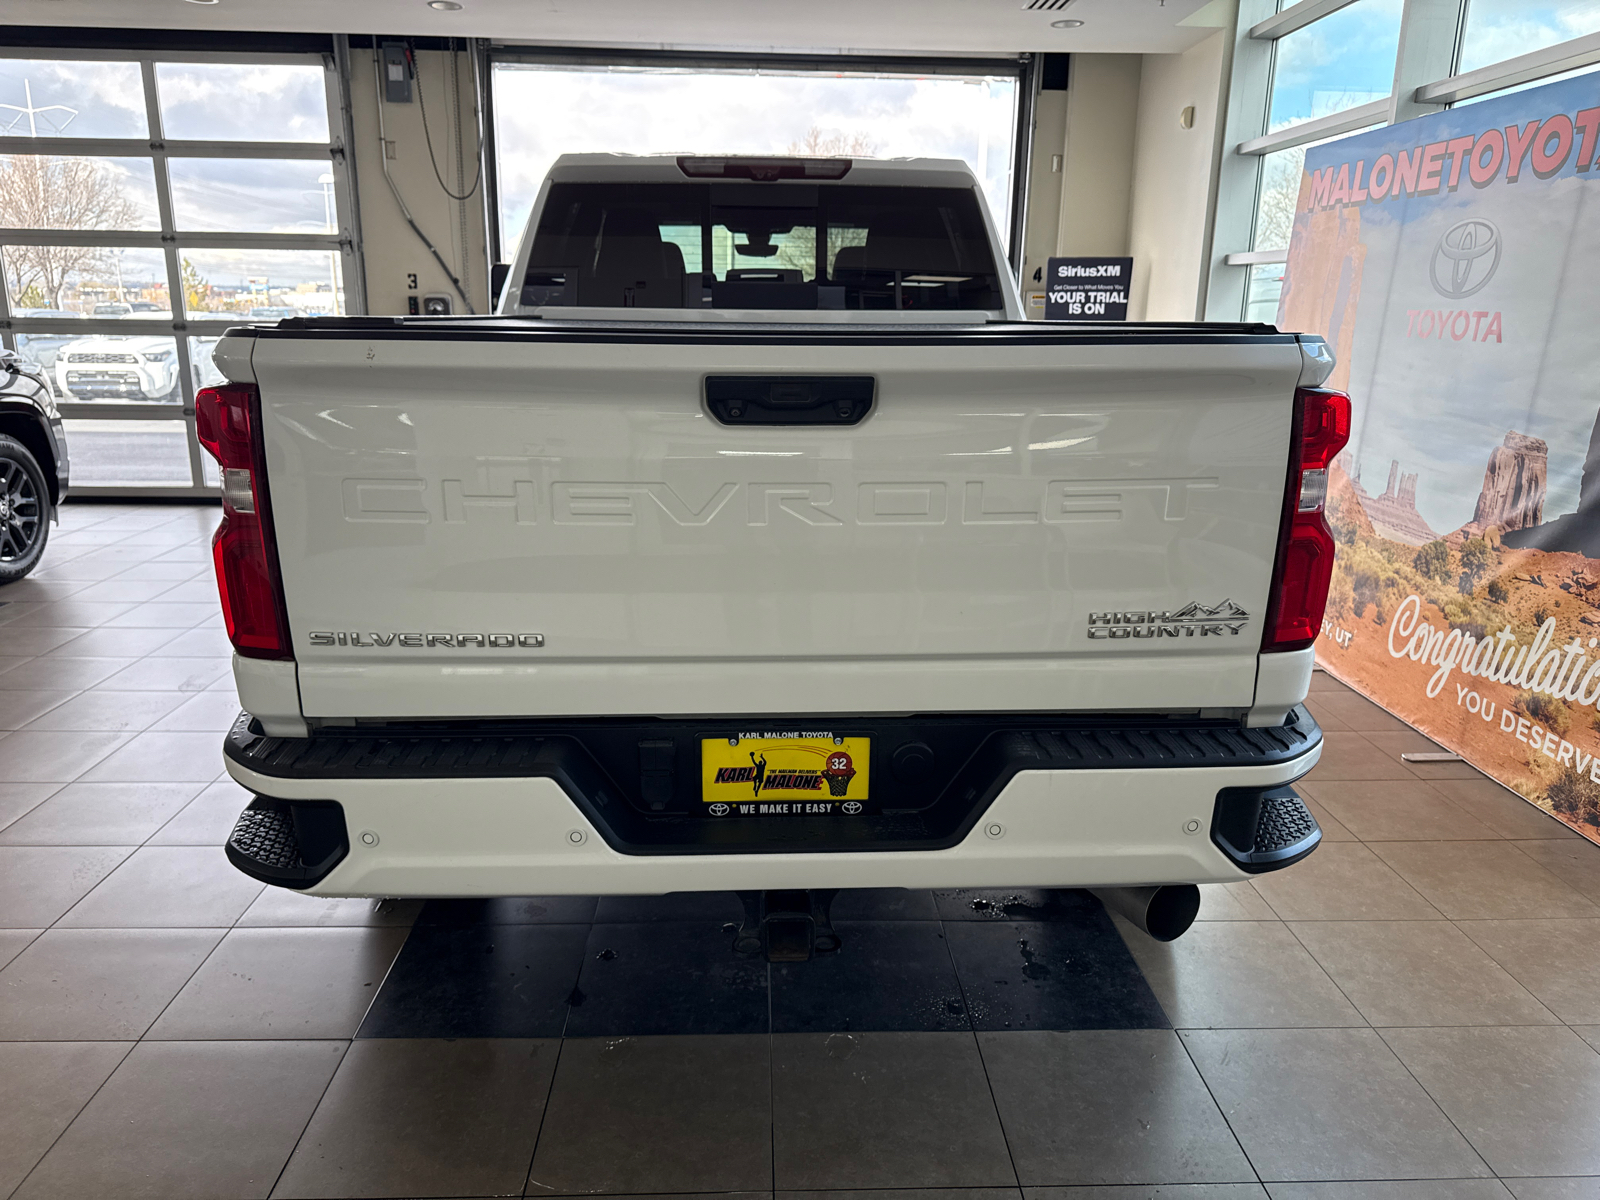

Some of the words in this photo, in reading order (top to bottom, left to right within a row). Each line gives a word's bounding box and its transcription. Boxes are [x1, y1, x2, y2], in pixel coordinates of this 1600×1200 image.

[1307, 106, 1600, 212] MALONETOYOT
[1033, 266, 1042, 283] 4
[1057, 265, 1121, 277] SiriusXM
[407, 273, 418, 289] 3
[1048, 292, 1086, 303] YOUR
[1088, 292, 1128, 303] TRIAL
[1068, 303, 1082, 315] IS
[1084, 303, 1105, 315] ON
[1407, 309, 1503, 344] TOYOTA
[341, 477, 1219, 526] CHEVROLET
[1087, 610, 1171, 626] HIGH
[308, 630, 545, 648] SILVERADO
[1087, 622, 1248, 640] COUNTRY
[1335, 626, 1353, 648] UT
[1388, 594, 1600, 711] Congratulatio
[1456, 683, 1496, 722] YOU
[1500, 708, 1600, 784] DESERVE
[831, 758, 847, 770] 32
[714, 766, 756, 784] KARL
[762, 774, 824, 790] MALONE
[740, 804, 756, 814] WE
[759, 804, 789, 813] MAKE
[792, 804, 802, 813] IT
[806, 803, 832, 813] EASY
